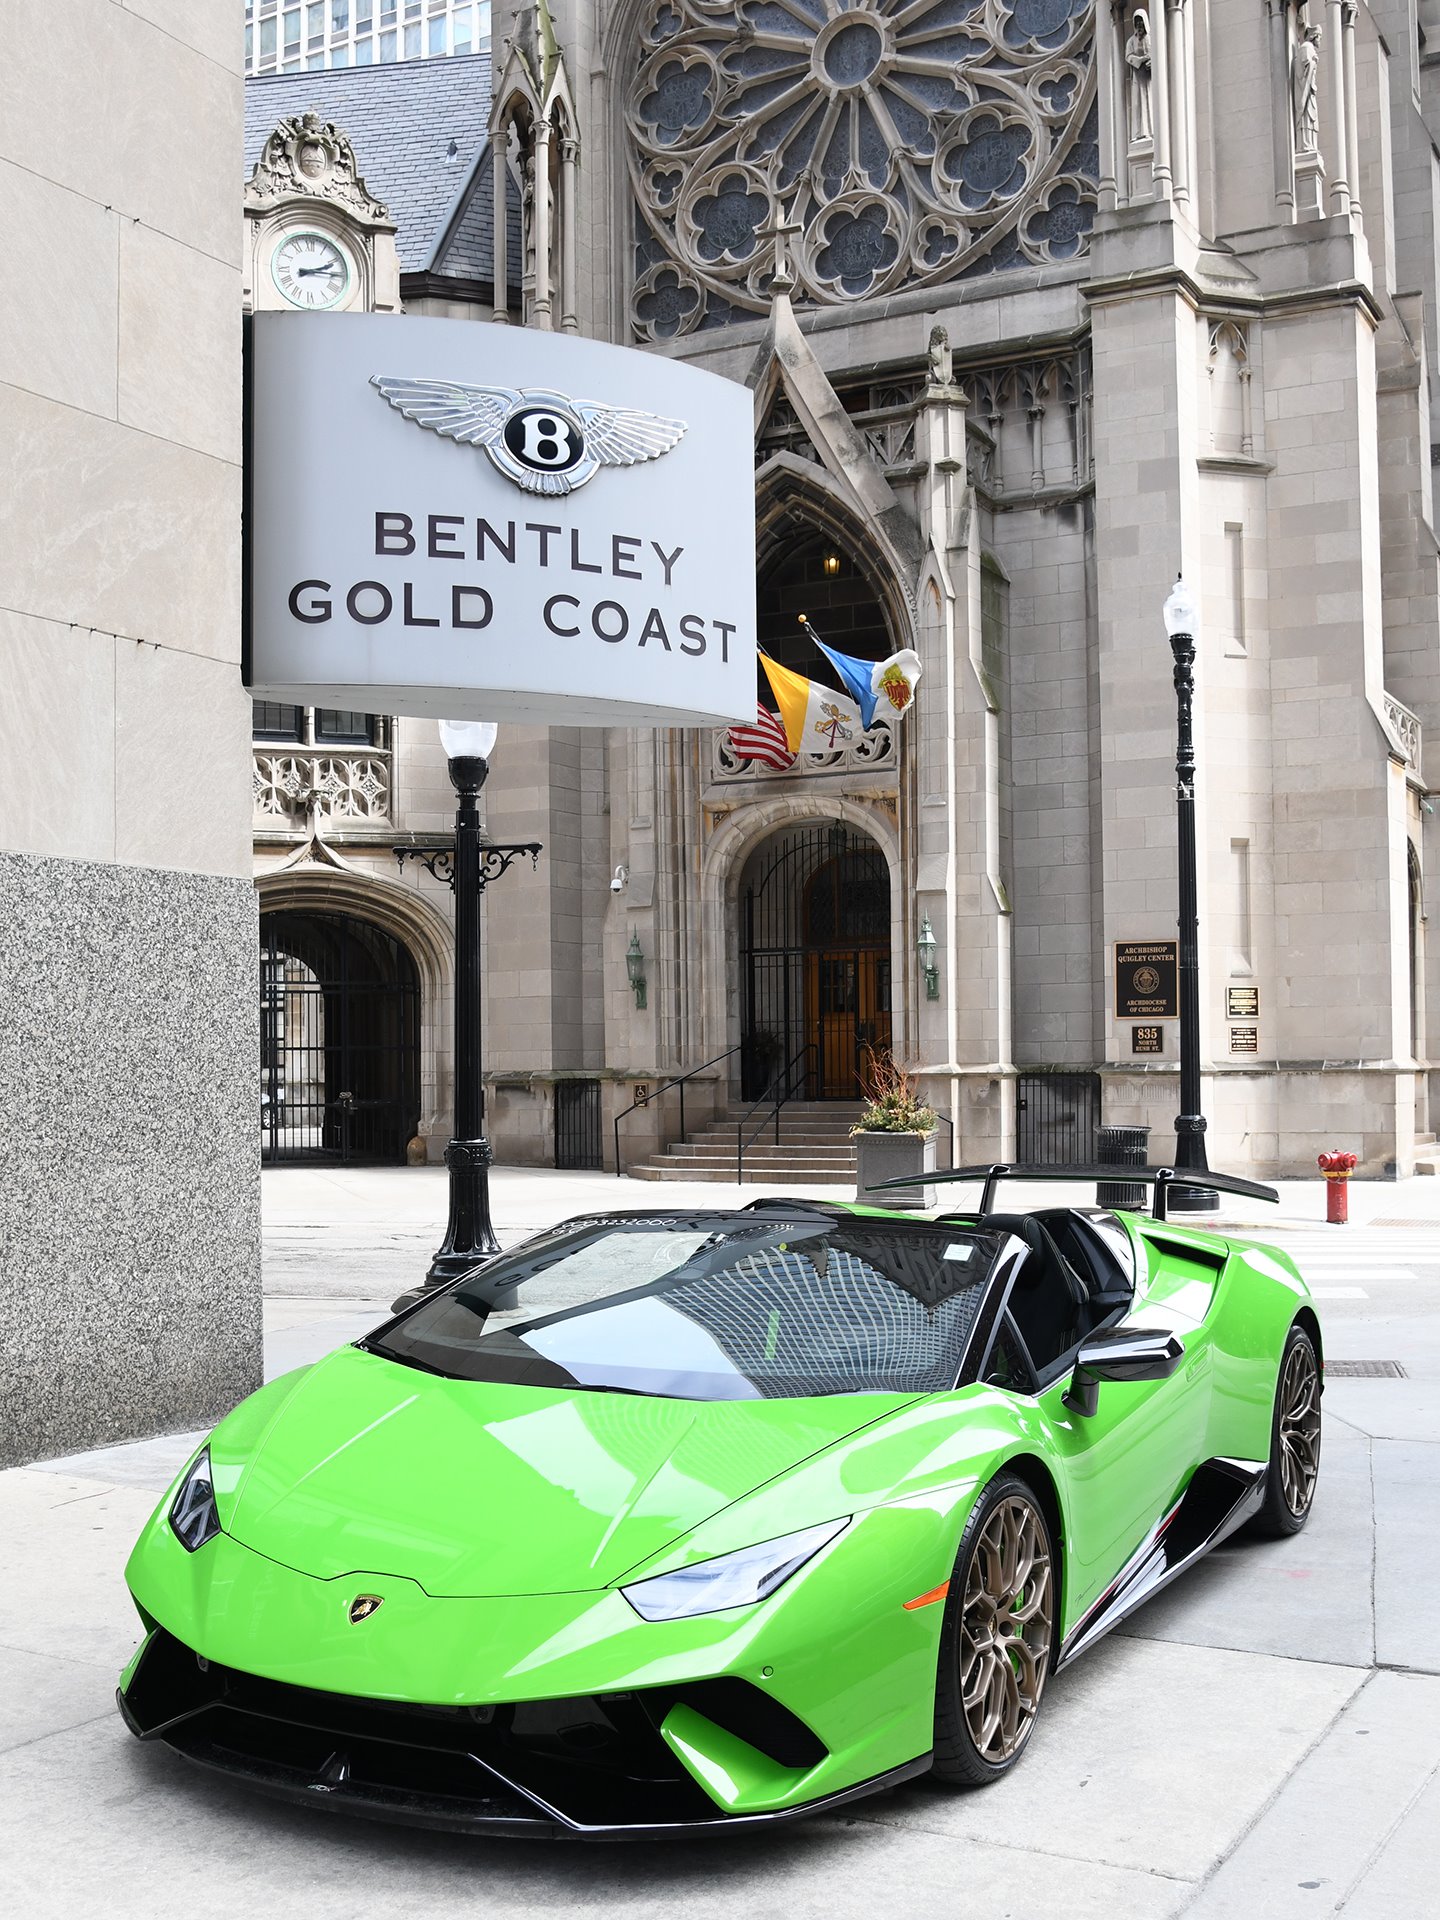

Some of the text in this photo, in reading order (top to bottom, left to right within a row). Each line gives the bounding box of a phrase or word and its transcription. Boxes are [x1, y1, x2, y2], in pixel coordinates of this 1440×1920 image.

[521, 413, 571, 465] B
[375, 512, 684, 586] BENTLEY
[288, 579, 737, 663] GOLD COAST
[1118, 955, 1147, 963] QUIGLEY
[1125, 946, 1167, 954] ARCHBISHOP
[1137, 1027, 1157, 1040] 835
